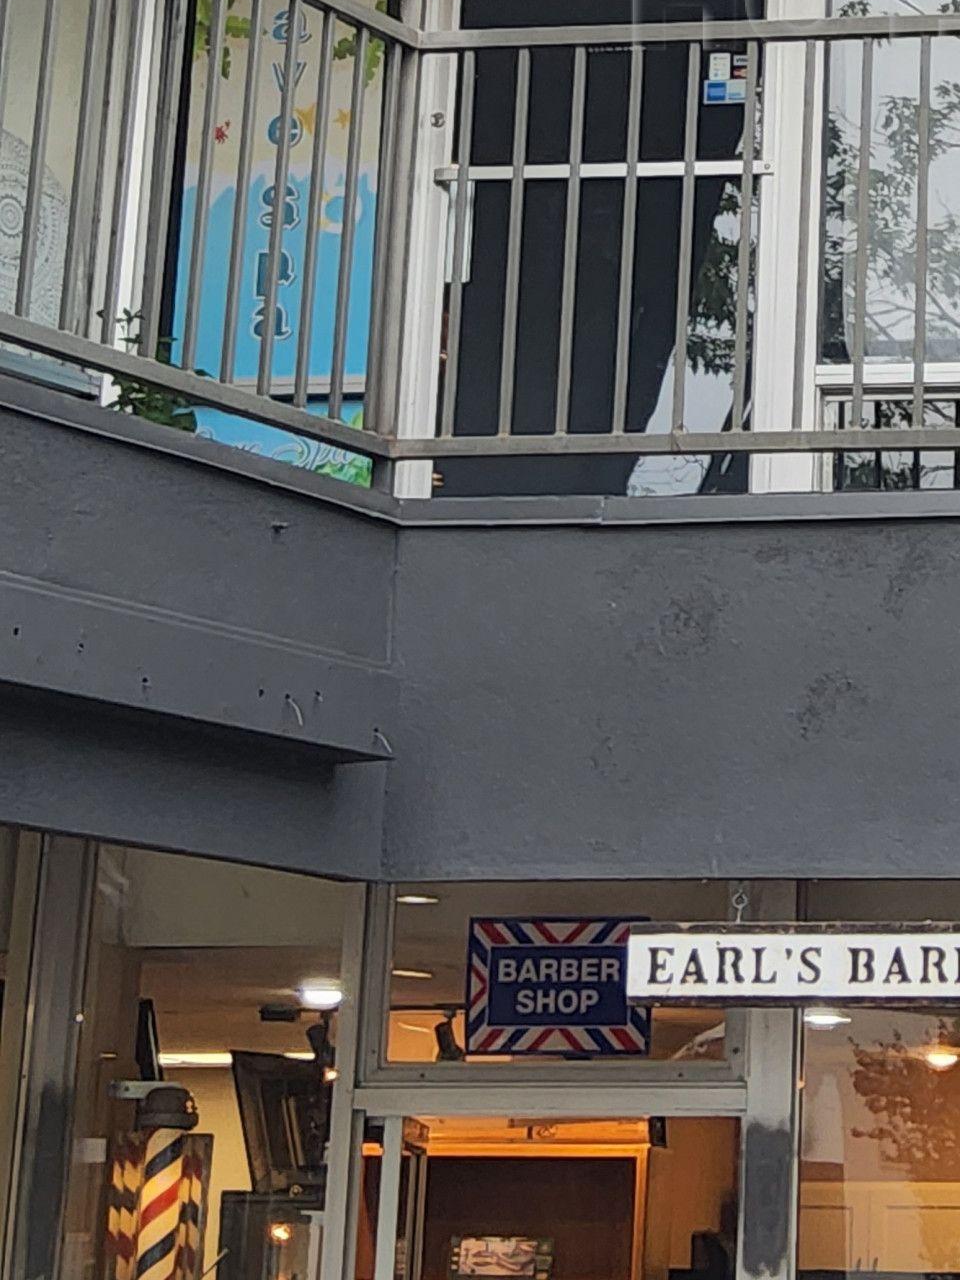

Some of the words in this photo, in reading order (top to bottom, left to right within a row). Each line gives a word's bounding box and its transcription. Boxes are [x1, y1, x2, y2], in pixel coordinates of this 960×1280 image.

[498, 956, 620, 985] BARBER
[646, 944, 823, 986] EARL'S
[516, 988, 600, 1016] SHOP
